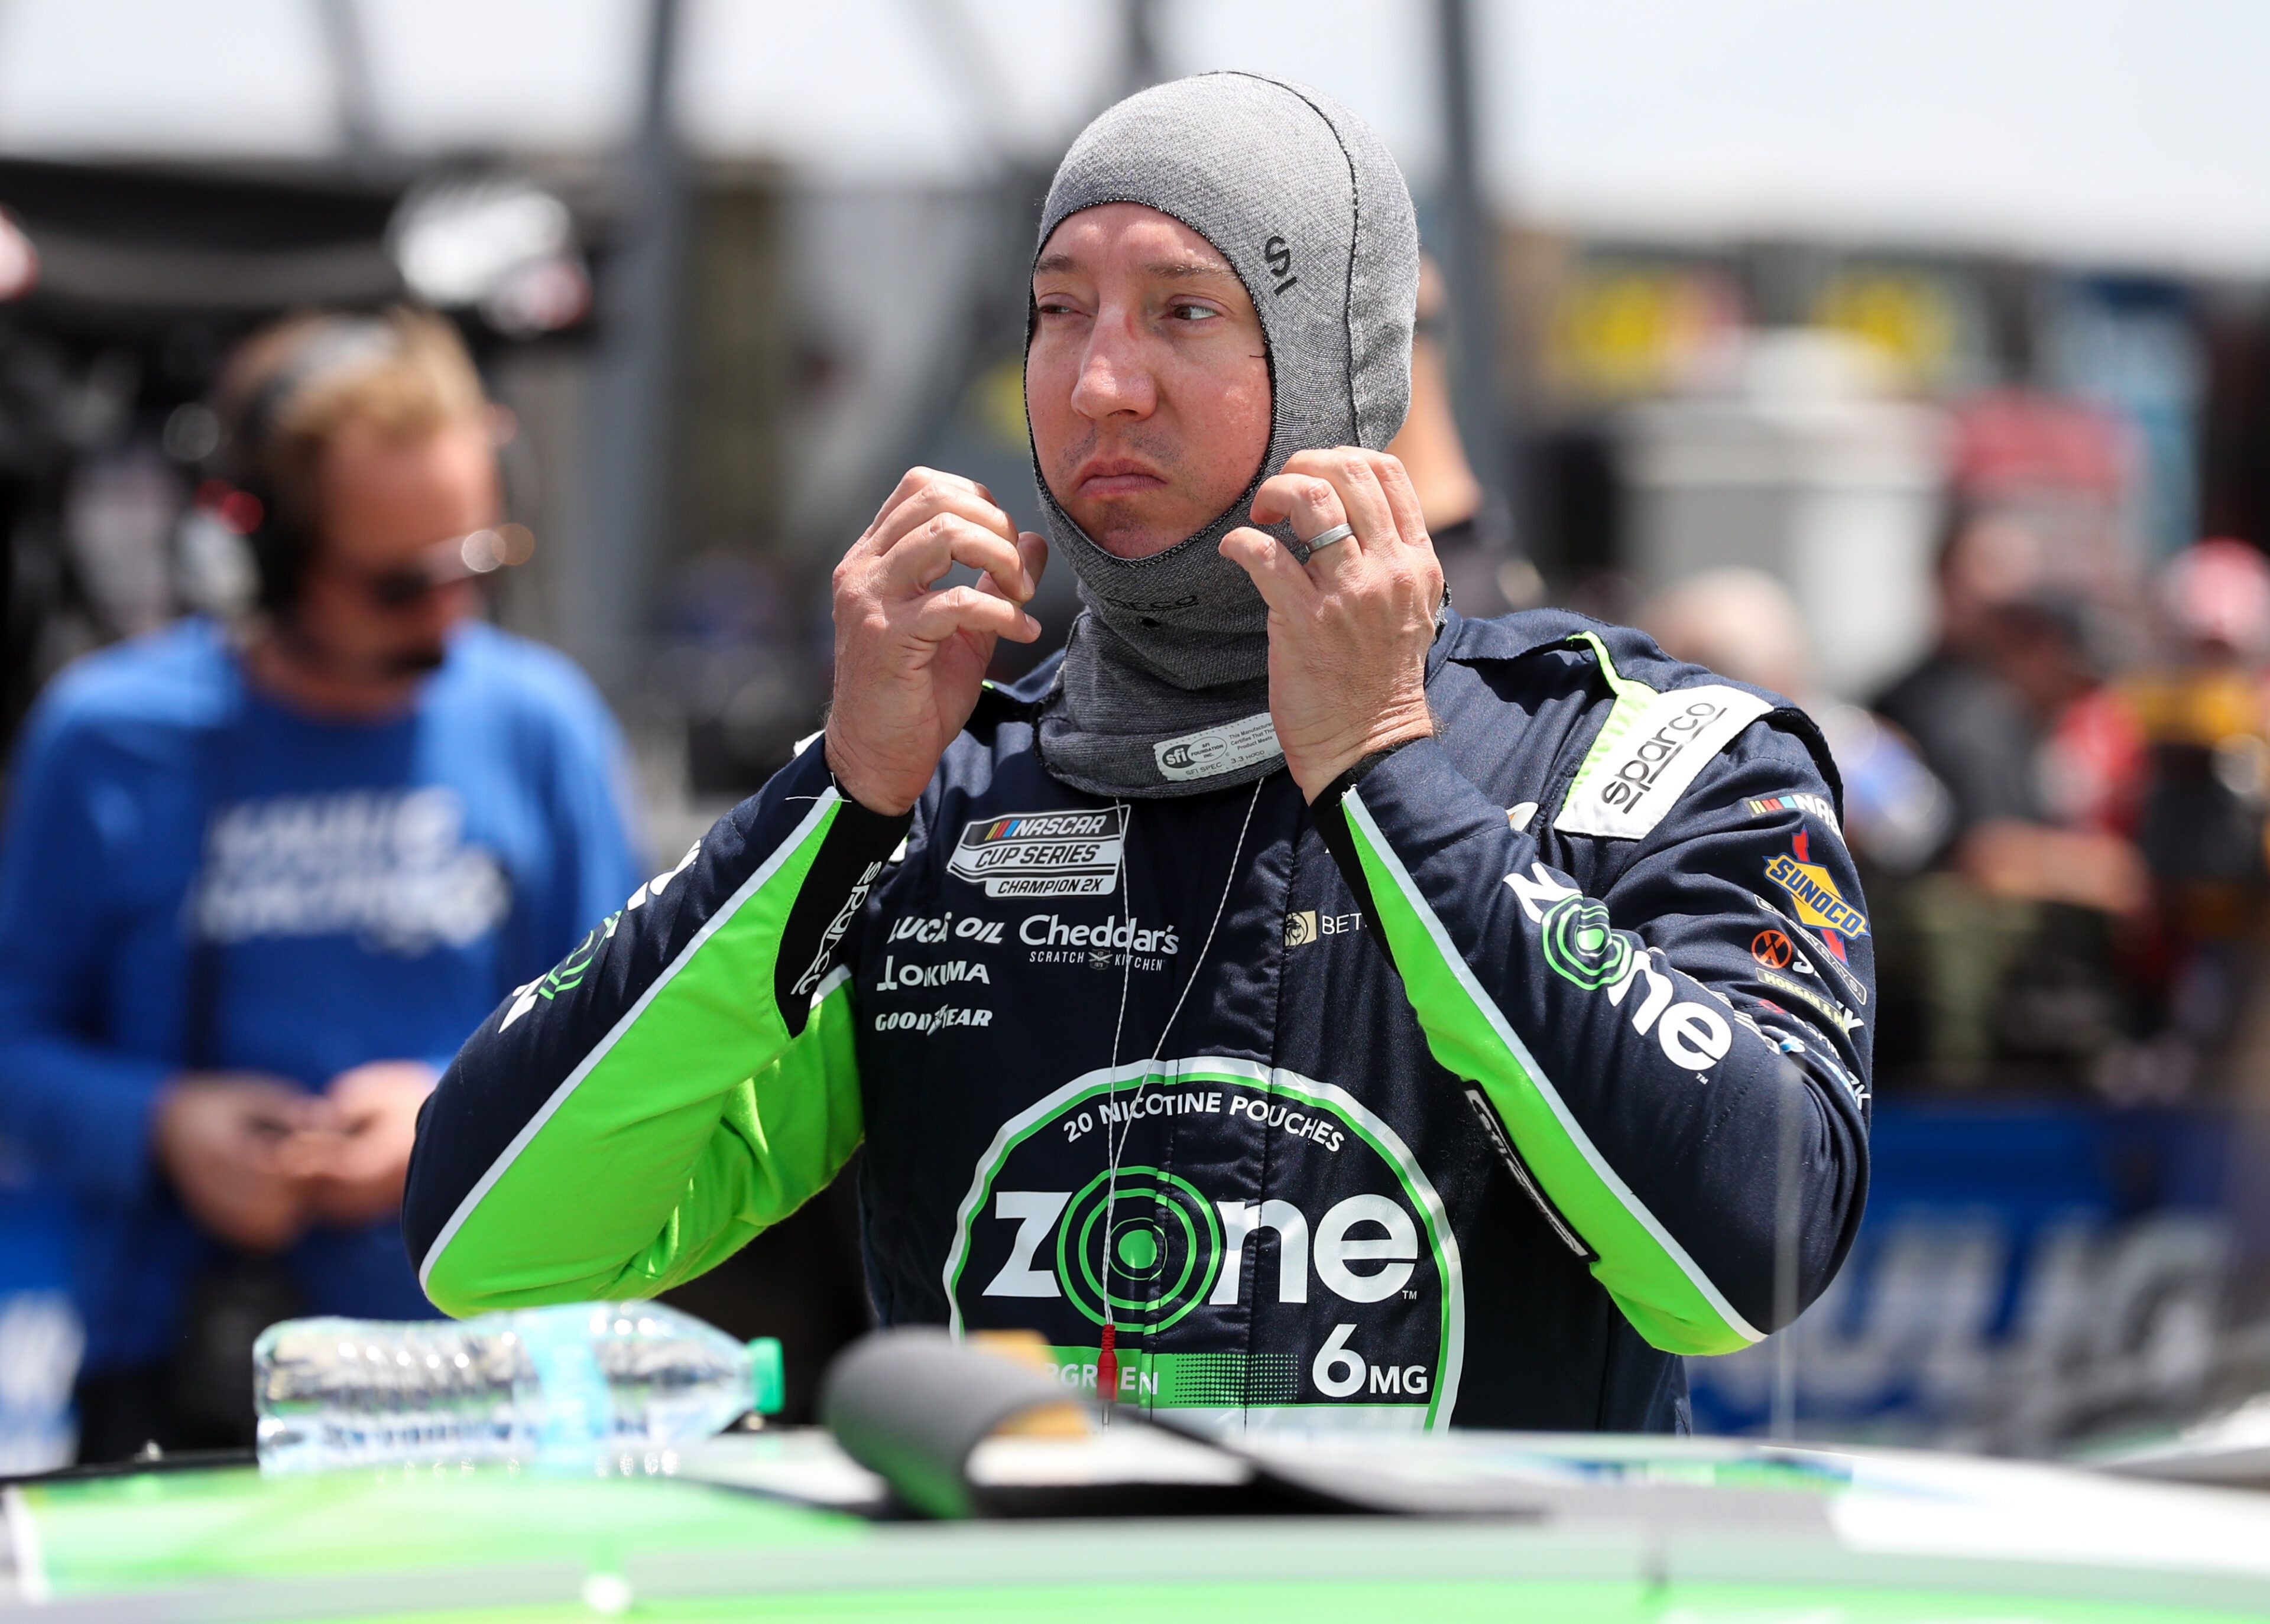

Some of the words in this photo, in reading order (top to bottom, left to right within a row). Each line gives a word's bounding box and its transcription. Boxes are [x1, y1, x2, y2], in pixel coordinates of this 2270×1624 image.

[1241, 722, 1273, 736] Manufacturer
[1252, 732, 1264, 740] That
[1191, 743, 1224, 757] FOUNDATION
[1237, 740, 1257, 751] Product
[1257, 736, 1273, 744] Meets
[1246, 750, 1264, 760] HOOD
[1601, 703, 1716, 805] sparco
[1166, 747, 1188, 765] sfi
[1011, 815, 1107, 837] NASCAR
[1792, 794, 1842, 837] NAS
[975, 846, 1021, 868] CUP
[1020, 844, 1100, 865] SERIES
[997, 879, 1080, 894] CHAMPION
[1081, 878, 1104, 892] 2X
[1769, 859, 1862, 933] SUNOCO
[790, 861, 882, 995] sparco
[887, 912, 952, 944] LUCA
[955, 917, 1005, 944] OIL
[1019, 914, 1179, 954] Cheddar's
[1322, 912, 1362, 935] BET
[1029, 951, 1084, 963] SCRATCH
[1115, 954, 1163, 971] KITCHEN
[1764, 973, 1821, 1008] MORGAN
[875, 1003, 993, 1036] GOODEAR
[1063, 1112, 1093, 1143] 20
[1098, 1092, 1222, 1124] NICOTINE
[1229, 1094, 1345, 1152] POUCHES
